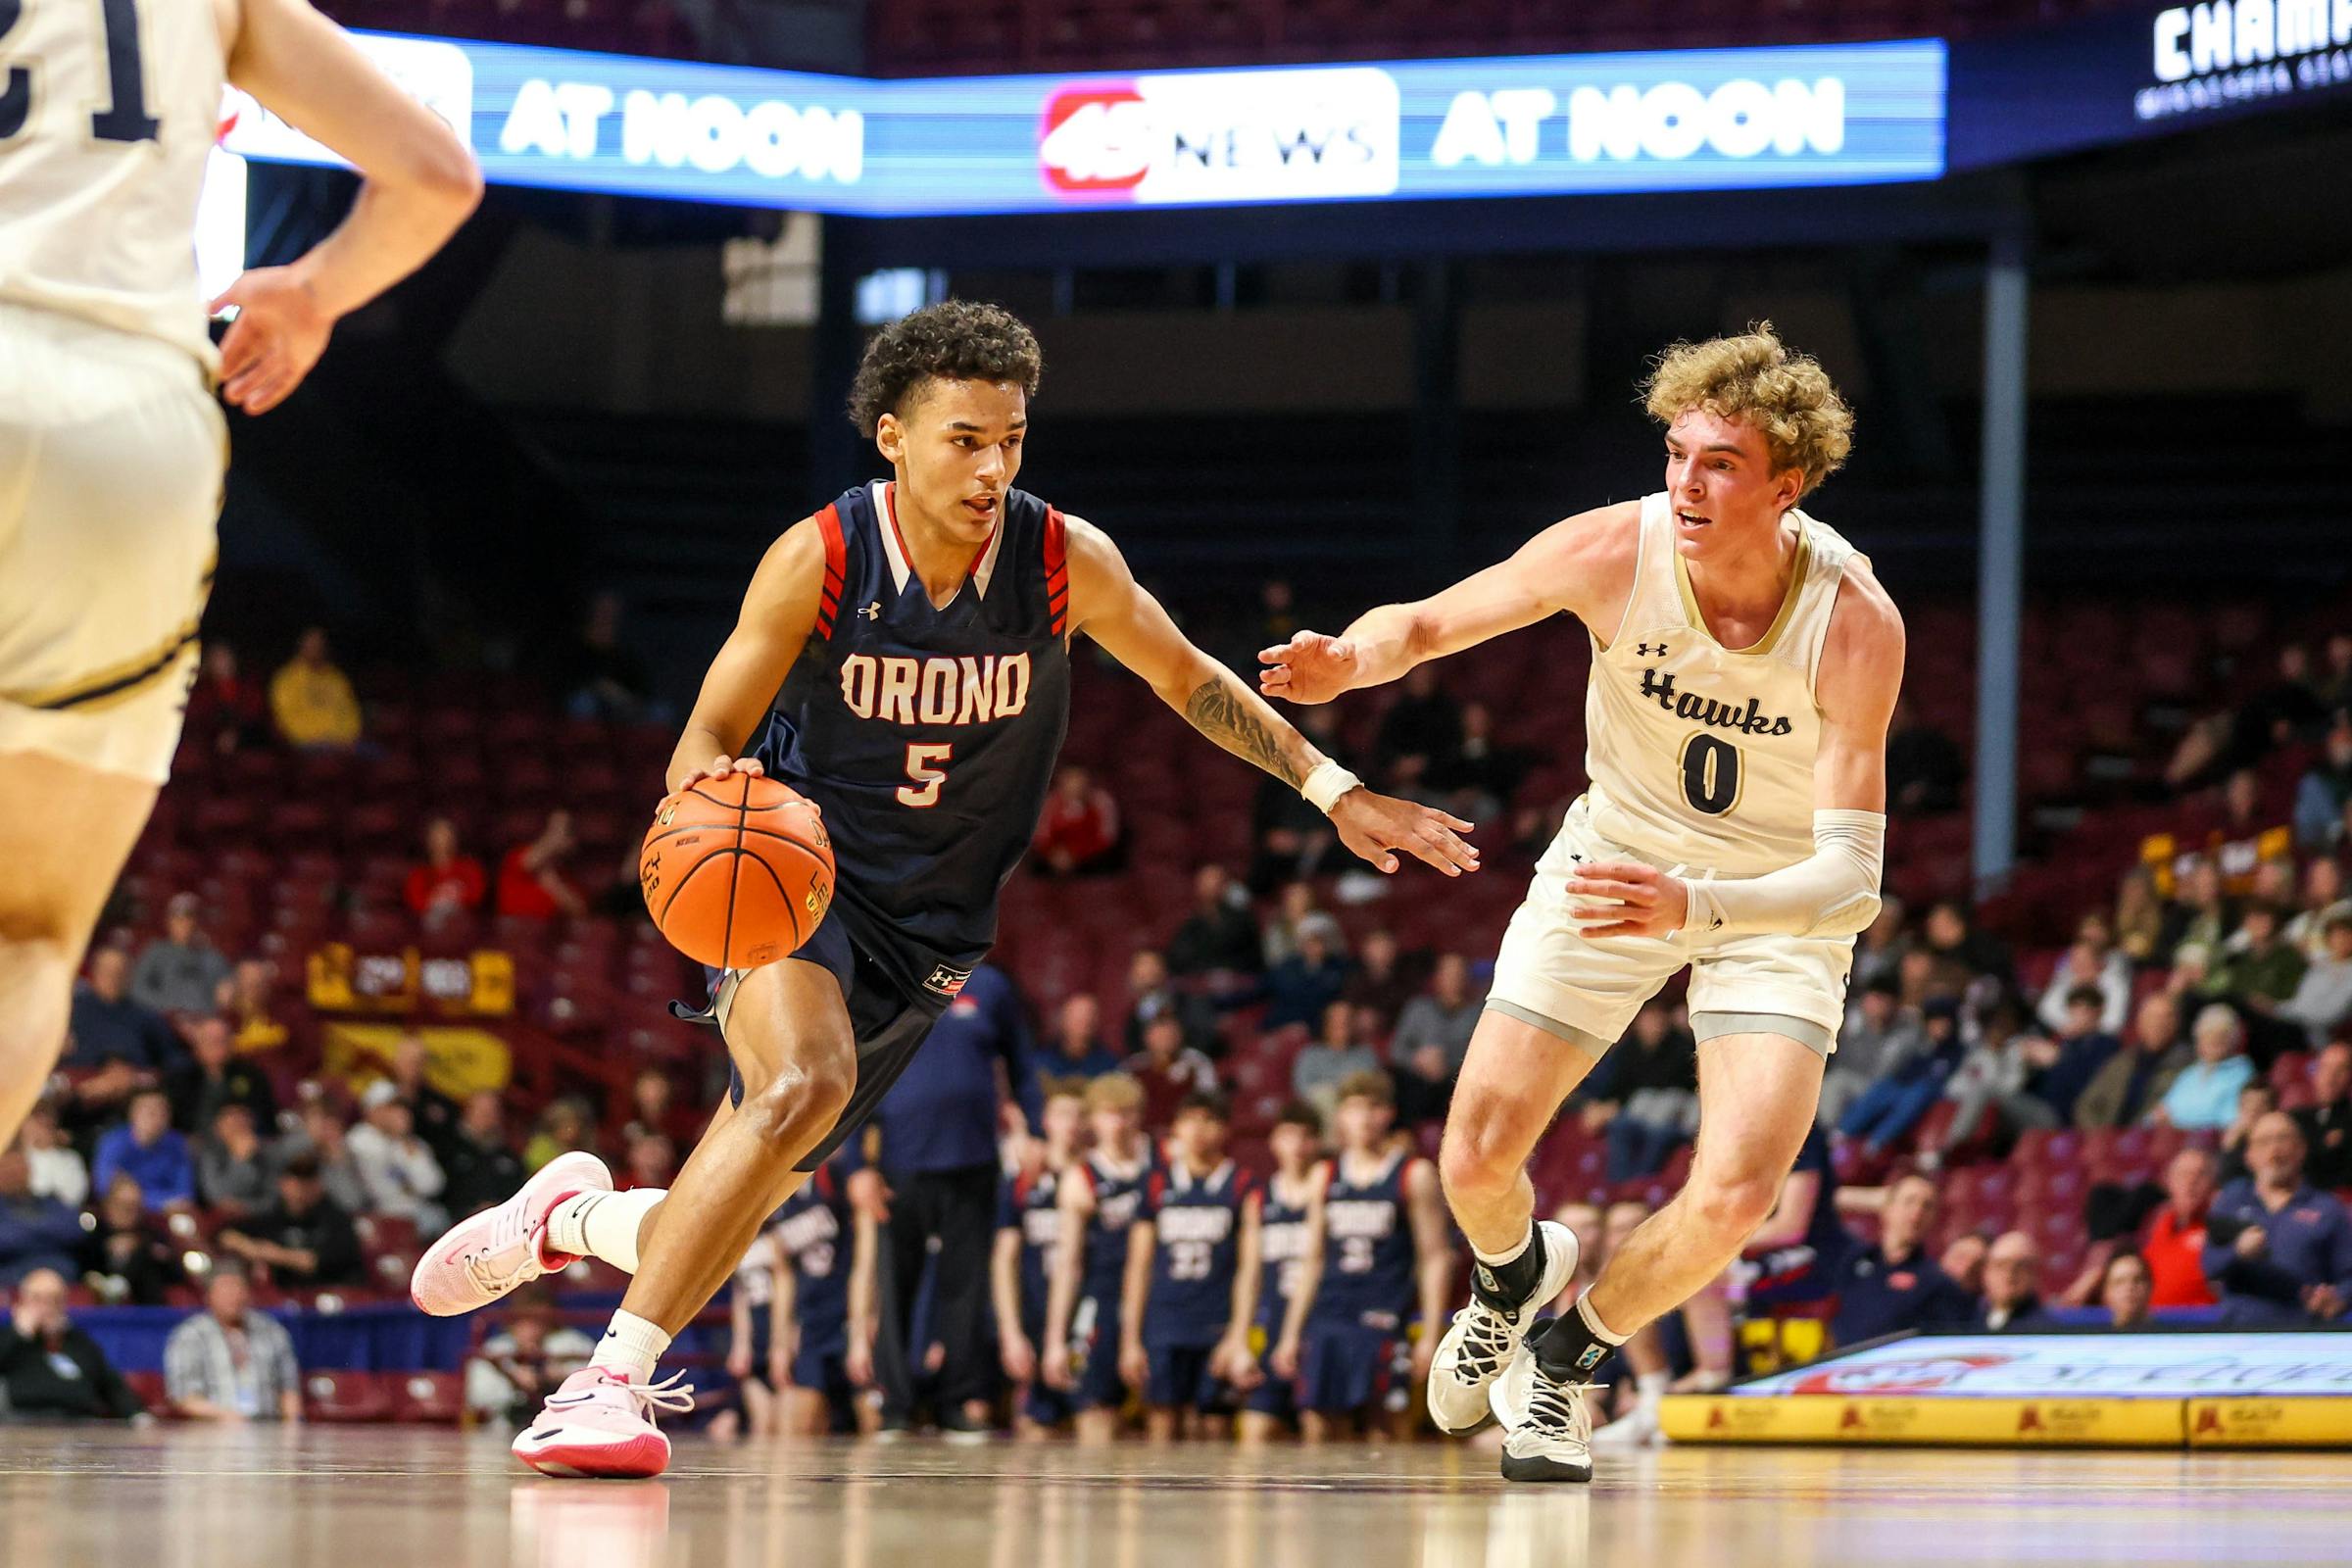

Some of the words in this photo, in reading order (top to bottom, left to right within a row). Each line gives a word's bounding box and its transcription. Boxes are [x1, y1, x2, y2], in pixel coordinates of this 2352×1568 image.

[500, 78, 614, 160] AT
[622, 89, 864, 183] NOON
[1173, 122, 1375, 168] NEWS
[1430, 90, 1556, 167] AT
[1570, 76, 1845, 166] NOON
[841, 651, 1030, 725] ORONO
[1639, 667, 1793, 736] Hawks
[896, 743, 952, 808] 5
[1679, 731, 1743, 818] 0
